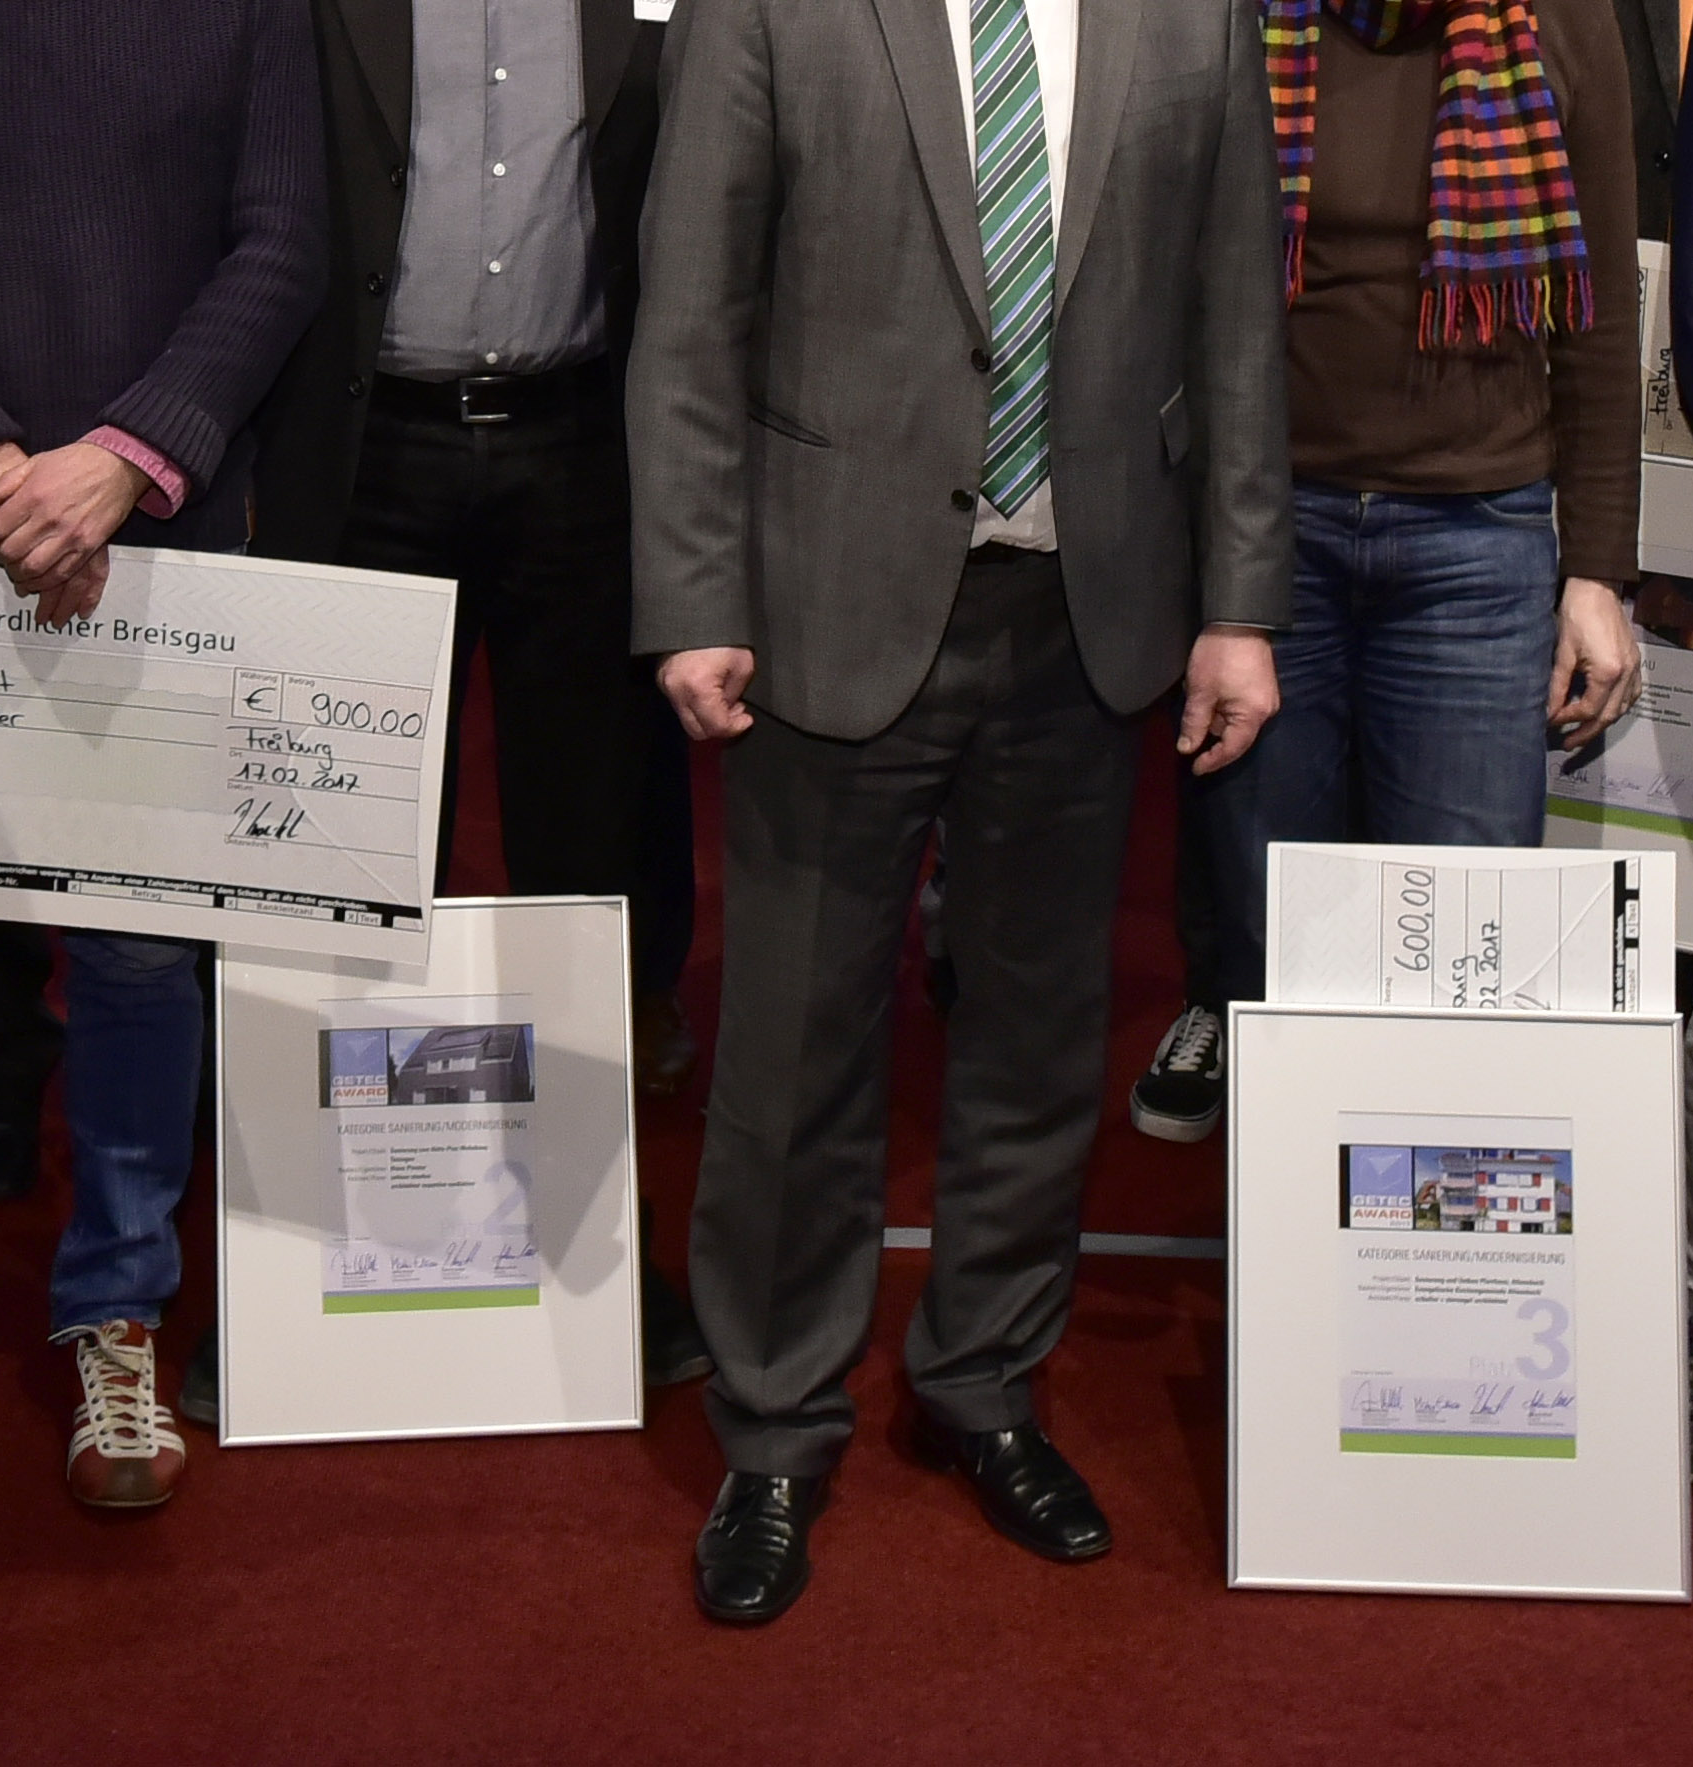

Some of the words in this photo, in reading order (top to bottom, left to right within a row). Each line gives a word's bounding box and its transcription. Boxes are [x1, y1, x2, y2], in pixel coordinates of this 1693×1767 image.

[113, 618, 236, 655] Breisgau
[242, 686, 277, 714] €
[310, 692, 423, 739] 900,00
[226, 725, 333, 772] Freiburg
[1393, 869, 1436, 973] 600,00
[332, 1086, 388, 1098] AWARD
[1353, 1209, 1412, 1220] AWARD
[1357, 1248, 1410, 1262] KATEGORIE
[1515, 1297, 1571, 1381] 3
